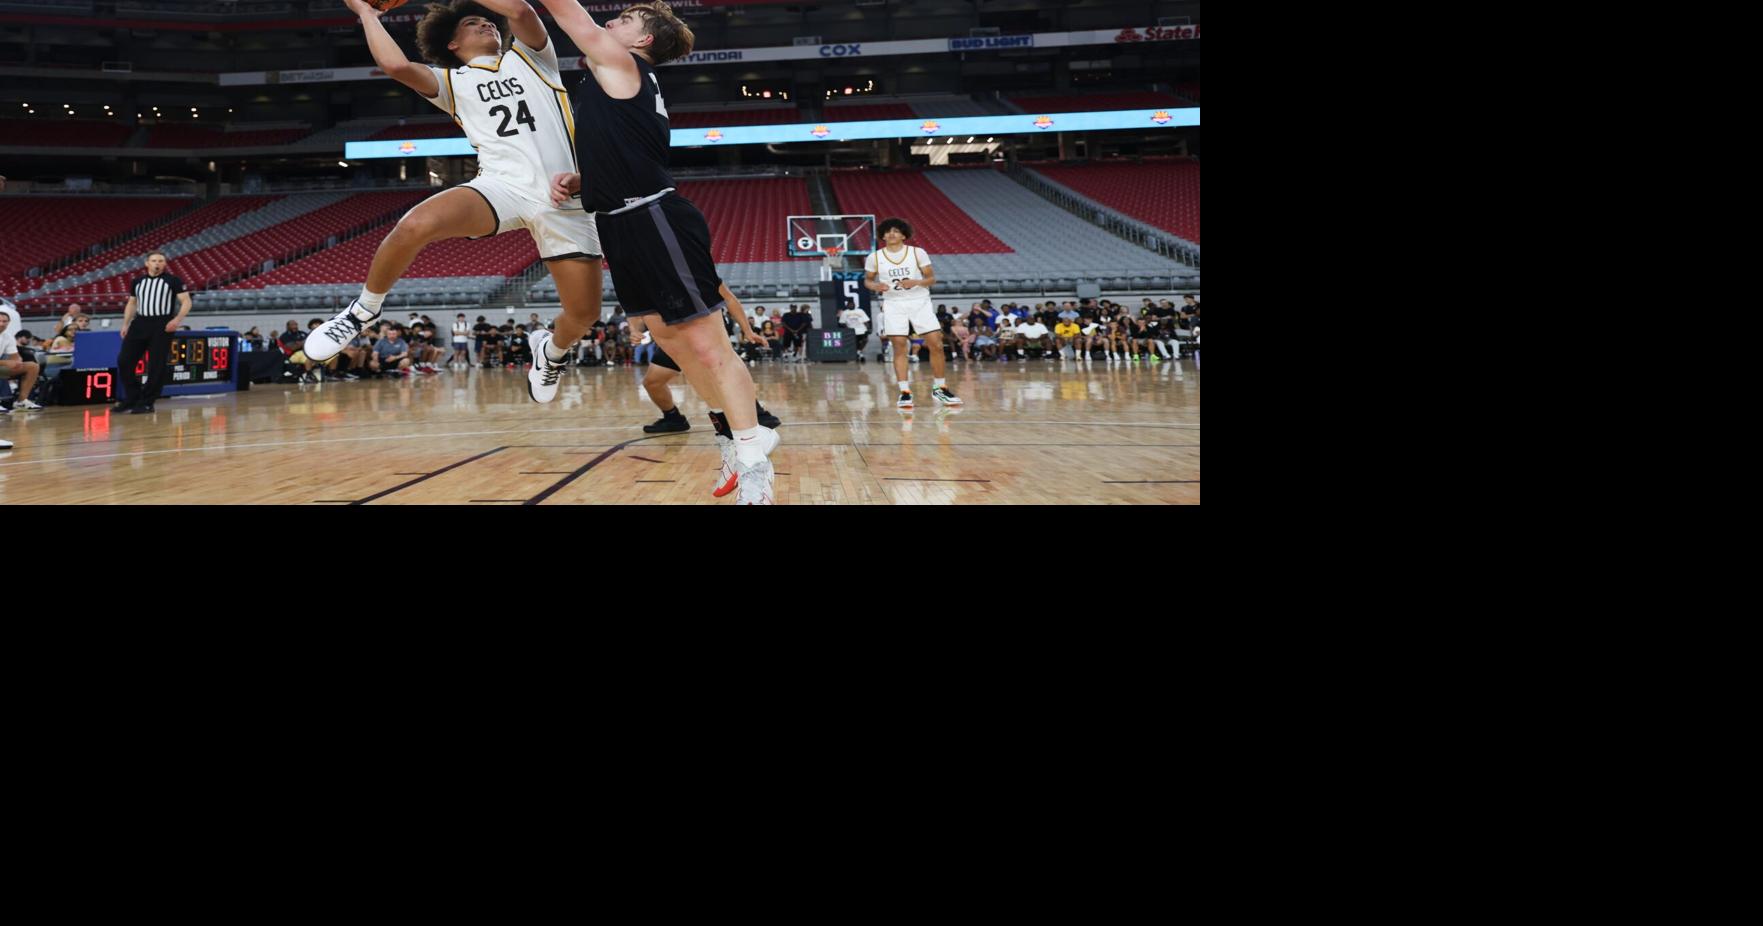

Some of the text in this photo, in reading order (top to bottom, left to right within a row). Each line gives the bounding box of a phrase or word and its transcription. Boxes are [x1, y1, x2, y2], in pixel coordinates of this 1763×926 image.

[952, 36, 1030, 49] BUD LIGHT
[1144, 26, 1192, 41] State
[820, 44, 861, 57] COX
[476, 77, 525, 102] CELTS
[489, 100, 537, 137] 24
[888, 267, 911, 277] CELTS
[207, 337, 229, 347] VISITOR
[169, 339, 205, 365] 5:13
[211, 347, 229, 370] 58
[86, 372, 112, 399] 19
